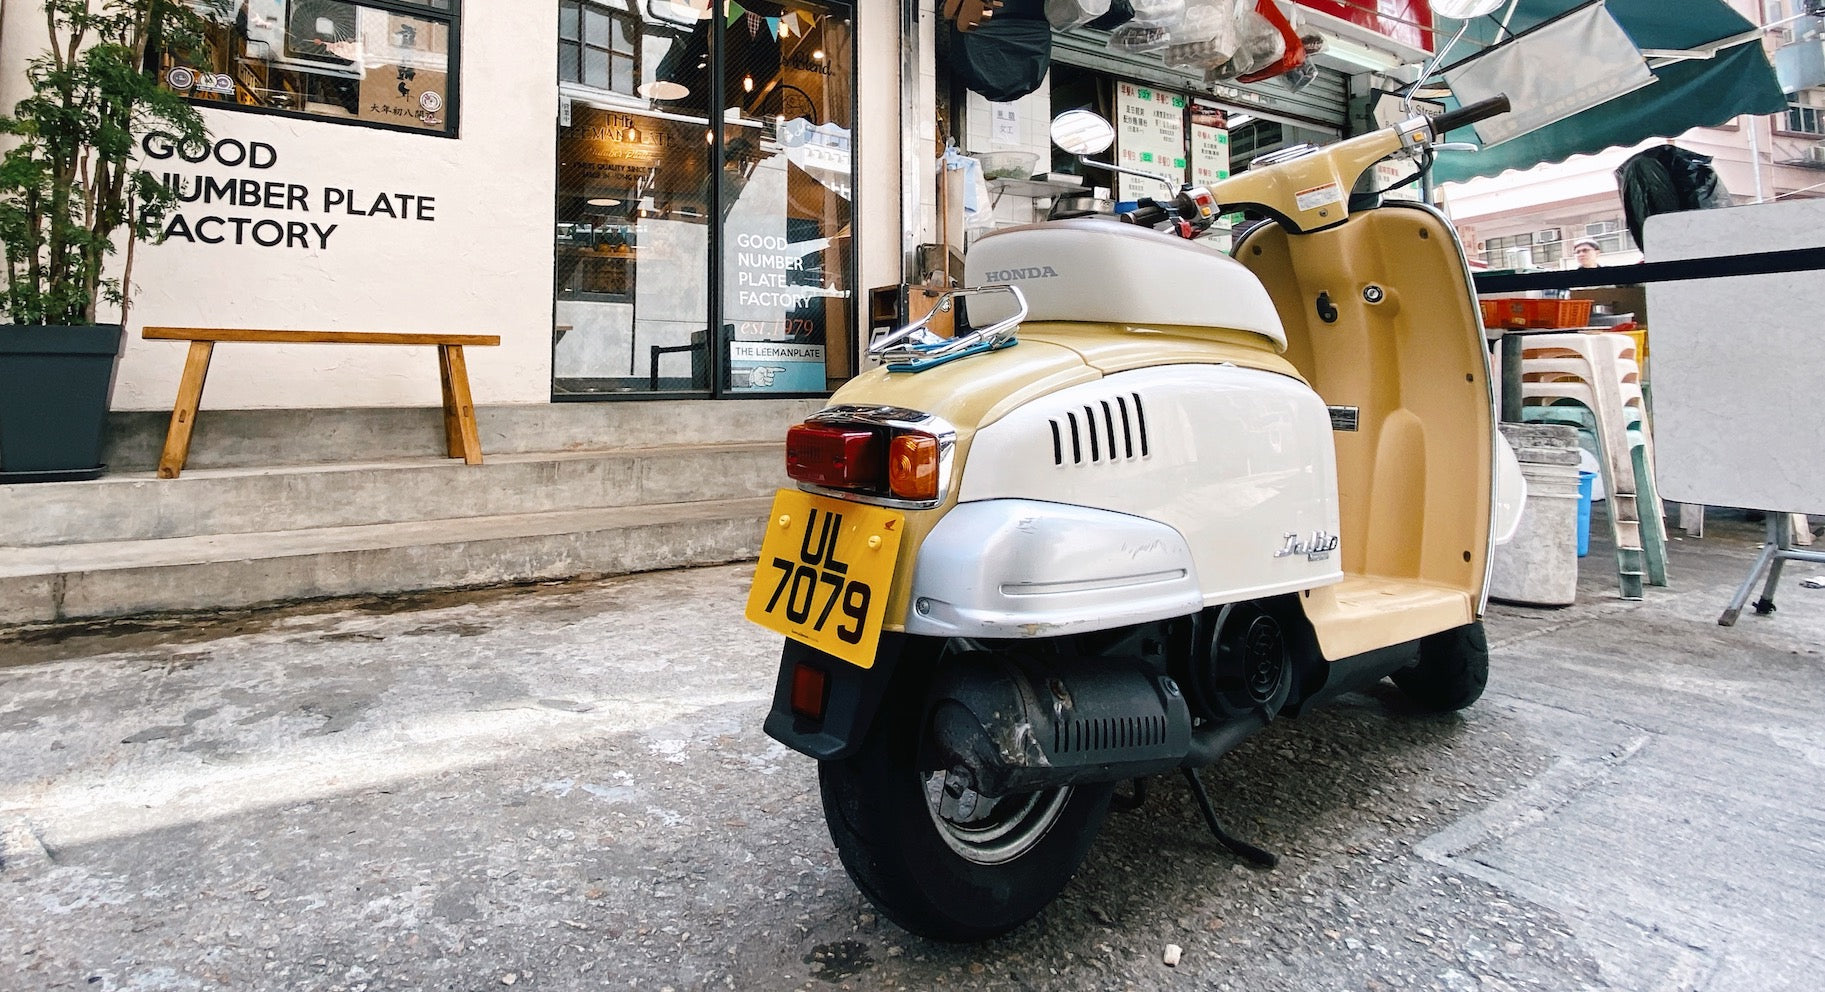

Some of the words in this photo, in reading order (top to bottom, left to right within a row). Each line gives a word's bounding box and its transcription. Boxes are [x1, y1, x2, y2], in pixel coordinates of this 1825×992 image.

[142, 131, 277, 169] GOOD
[323, 187, 435, 221] PLATE
[737, 234, 787, 250] GOOD
[738, 253, 804, 271] NUMBER
[738, 271, 786, 288] PLATE
[985, 266, 1058, 283] HONDA
[739, 291, 812, 308] FACTORY
[735, 347, 753, 356] THE
[756, 347, 820, 358] LEEMANPLATE
[801, 508, 849, 575] UL
[764, 557, 872, 645] 7079
